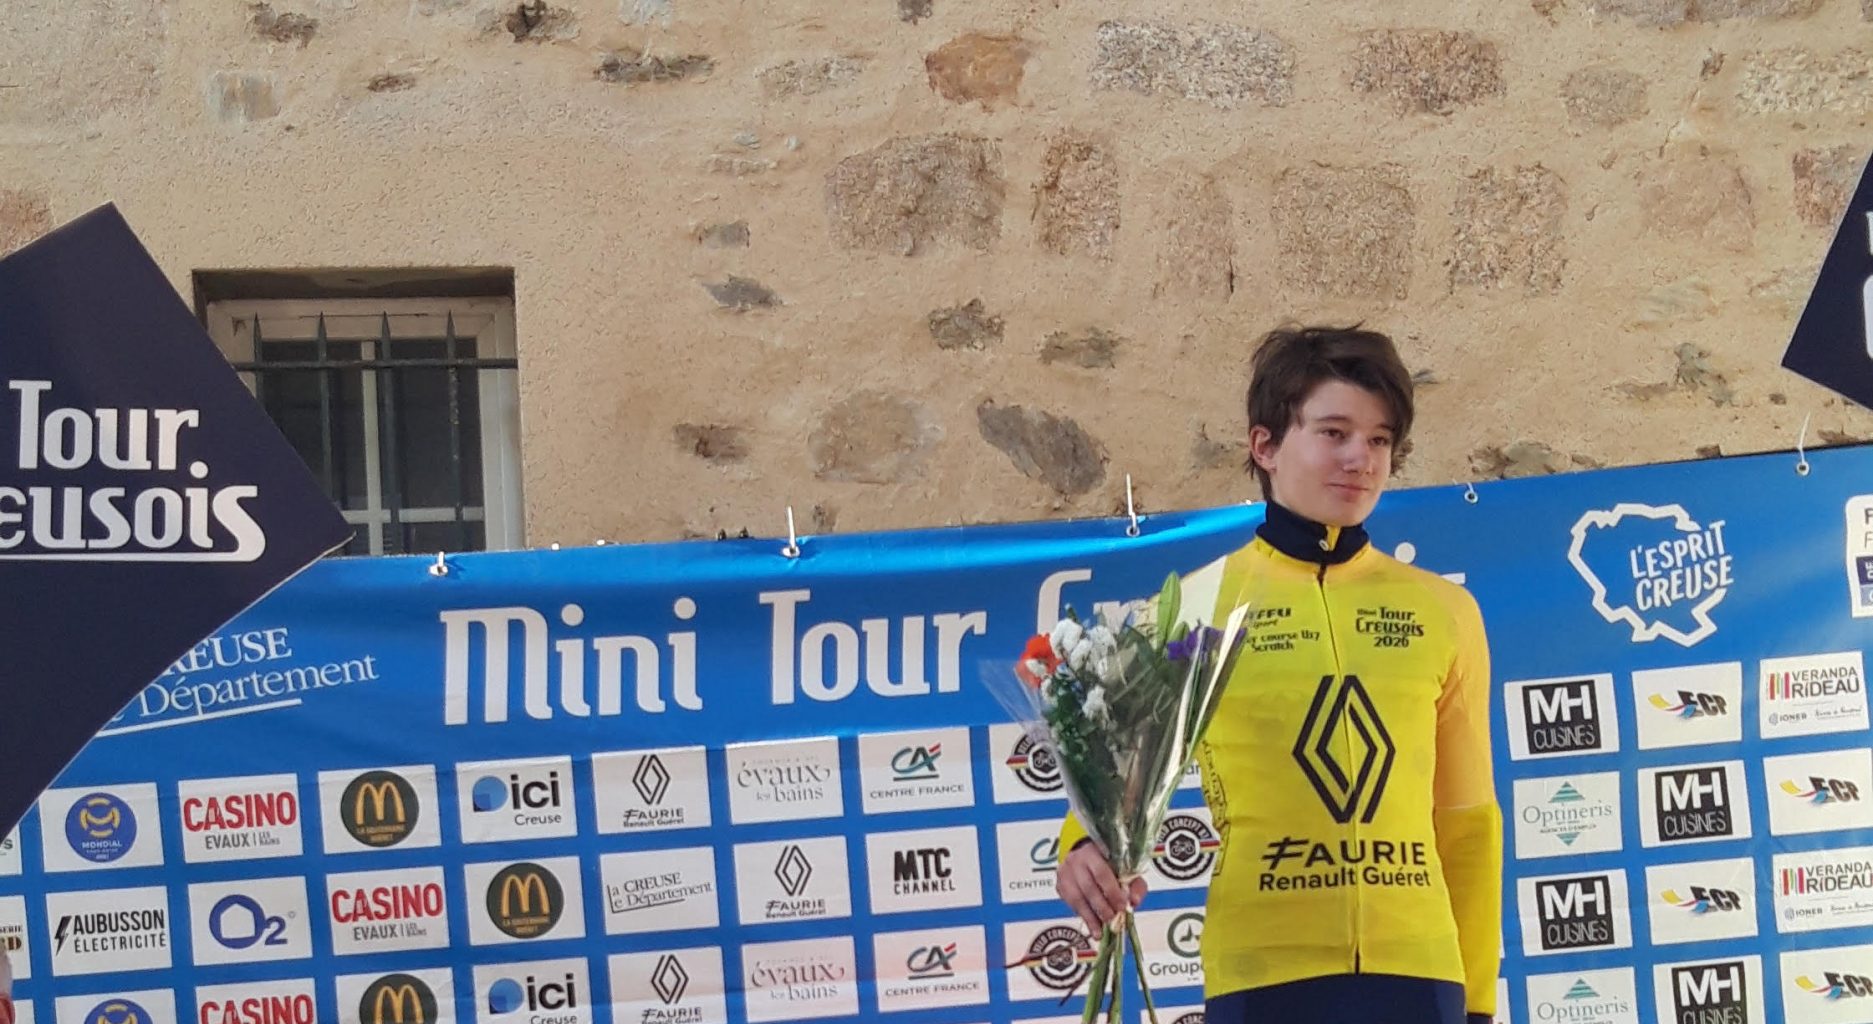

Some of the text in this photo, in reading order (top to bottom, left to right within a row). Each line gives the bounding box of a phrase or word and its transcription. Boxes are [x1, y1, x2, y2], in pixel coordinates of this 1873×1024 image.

[9, 380, 200, 470] Tour
[0, 461, 266, 562] eusois
[1631, 520, 1725, 578] L'ESPRIT
[1636, 555, 1733, 611] CREUSE
[1379, 606, 1416, 621] Tour
[1355, 617, 1425, 637] Creusois
[160, 627, 292, 677] EUSE
[1373, 635, 1410, 648] 2026
[439, 595, 702, 726] Mini
[760, 588, 986, 706] Tour
[139, 654, 380, 717] Département
[1792, 669, 1858, 682] VERANDA
[1529, 685, 1592, 725] MH
[1534, 723, 1595, 749] CUISINES
[737, 761, 830, 788] évaux
[511, 772, 561, 810] ici
[774, 785, 823, 803] bains
[870, 784, 965, 800] CENTRE FRANCE
[1661, 771, 1723, 811] MH
[184, 791, 297, 832] CASINO
[514, 814, 562, 826] Creuse
[623, 807, 684, 820] FAURIE
[1523, 800, 1613, 827] Optineris
[1665, 811, 1727, 836] CUISINES
[206, 833, 250, 850] EVAUX
[1263, 837, 1426, 869] FAURIE
[893, 847, 951, 881] MTC
[1806, 862, 1873, 876] VERANDA
[624, 872, 682, 893] CREUSE
[894, 880, 956, 895] CHANNEL
[1009, 879, 1053, 890] CENTRE
[1260, 866, 1430, 890] Renault Guéret
[331, 883, 443, 923] CASINO
[627, 881, 712, 907] Département
[765, 899, 825, 912] FAURIE
[1542, 880, 1606, 919] MH
[73, 909, 164, 936] AUBUSSON
[354, 924, 397, 941] EVAUX
[1547, 918, 1609, 944] CUISINES
[75, 930, 167, 953] ÉLECTRICITÉ
[751, 961, 845, 988] évaux
[1150, 962, 1204, 977] Group
[527, 973, 577, 1012] ici
[788, 985, 838, 1002] bains
[885, 982, 980, 997] CENTRE FRANCE
[1679, 966, 1740, 1007] MH
[641, 1006, 702, 1020] FAURIE
[1537, 996, 1629, 1022] Optineris
